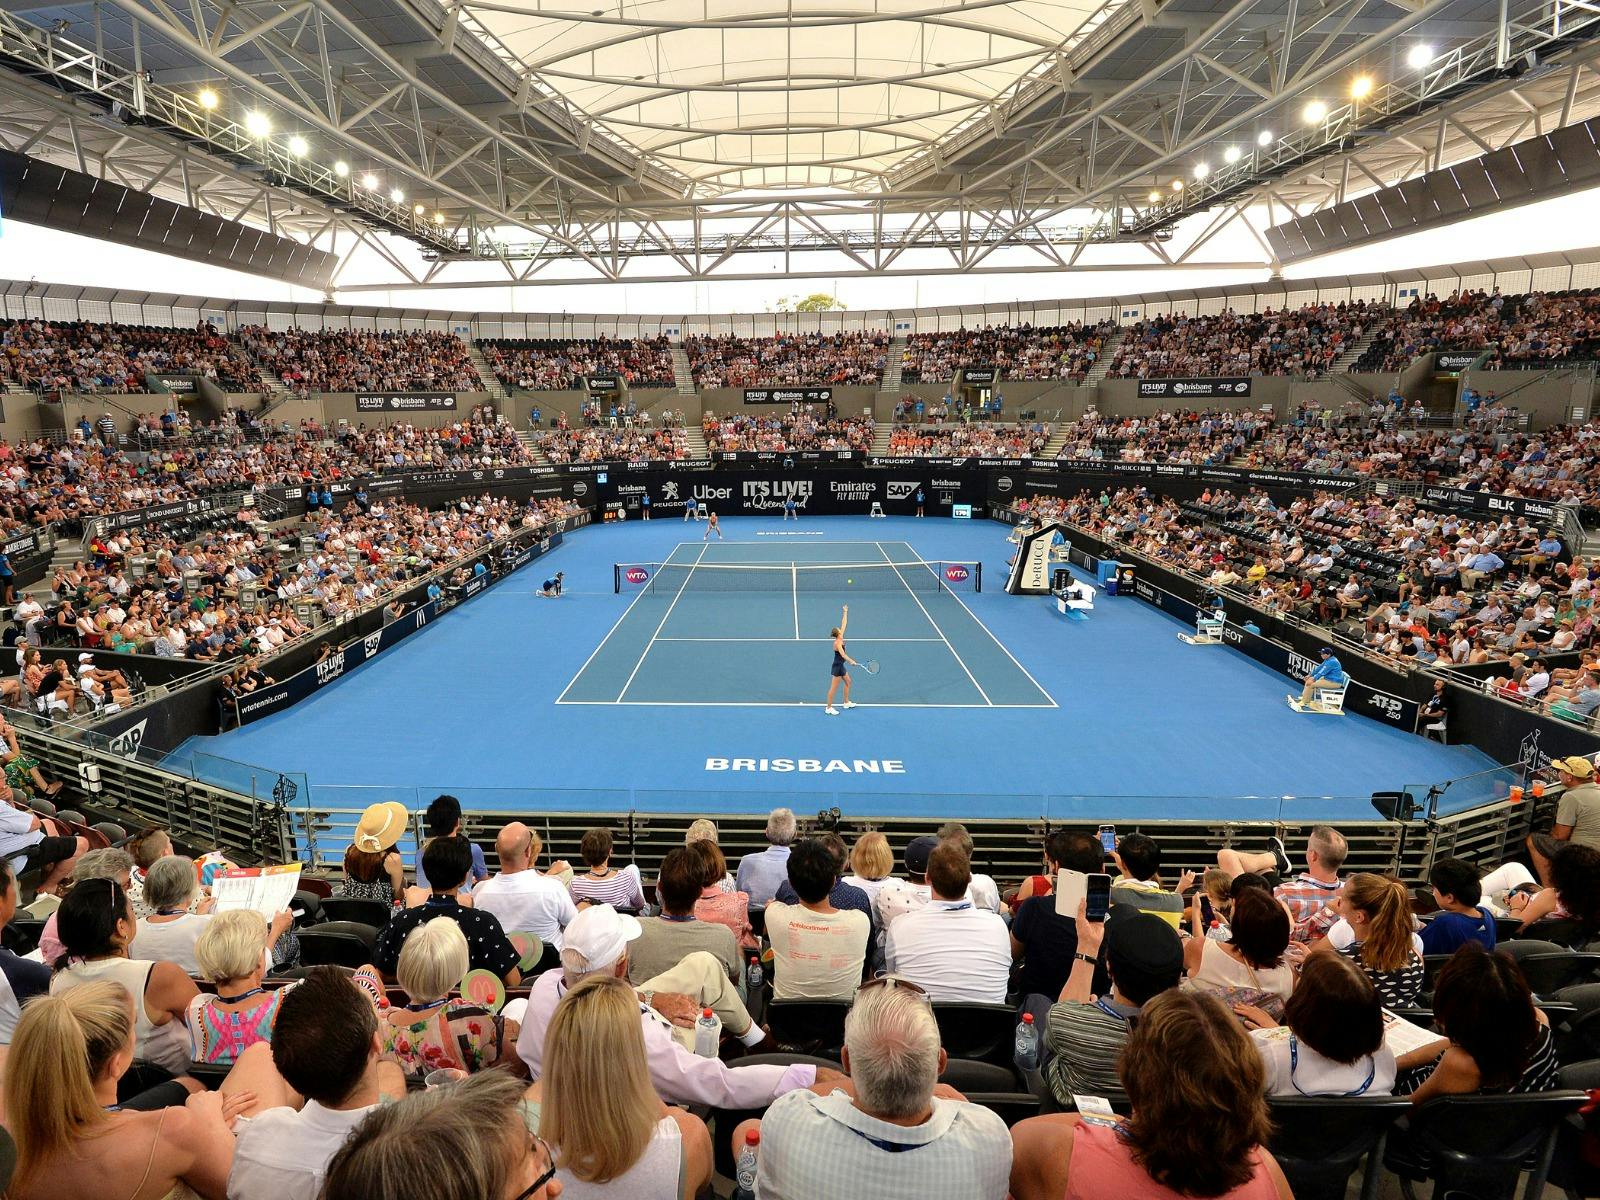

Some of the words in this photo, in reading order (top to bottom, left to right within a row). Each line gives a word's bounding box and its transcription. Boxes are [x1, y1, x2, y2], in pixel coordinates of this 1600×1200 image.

[331, 483, 351, 492] BLK
[743, 481, 770, 496] IT'S
[773, 481, 813, 496] LIVE!
[830, 481, 876, 491] Emirates
[888, 485, 912, 495] SAP
[1316, 479, 1356, 488] DUNLOP
[694, 485, 732, 499] Uber
[837, 492, 846, 500] FLY
[848, 492, 870, 500] BETTER
[753, 494, 808, 509] Queensnd
[1488, 498, 1514, 512] BLK
[1525, 503, 1553, 514] brisban
[1033, 539, 1044, 587] DeRUCCI
[366, 637, 378, 654] SAP
[317, 660, 329, 676] IT'S
[329, 652, 344, 670] LIVE!
[1288, 653, 1302, 668] IT'S
[1302, 659, 1315, 673] LIV
[241, 692, 288, 714] wtatennis.com
[1368, 694, 1402, 711] ATP
[1386, 711, 1401, 720] 250
[705, 758, 906, 774] BRISBANE
